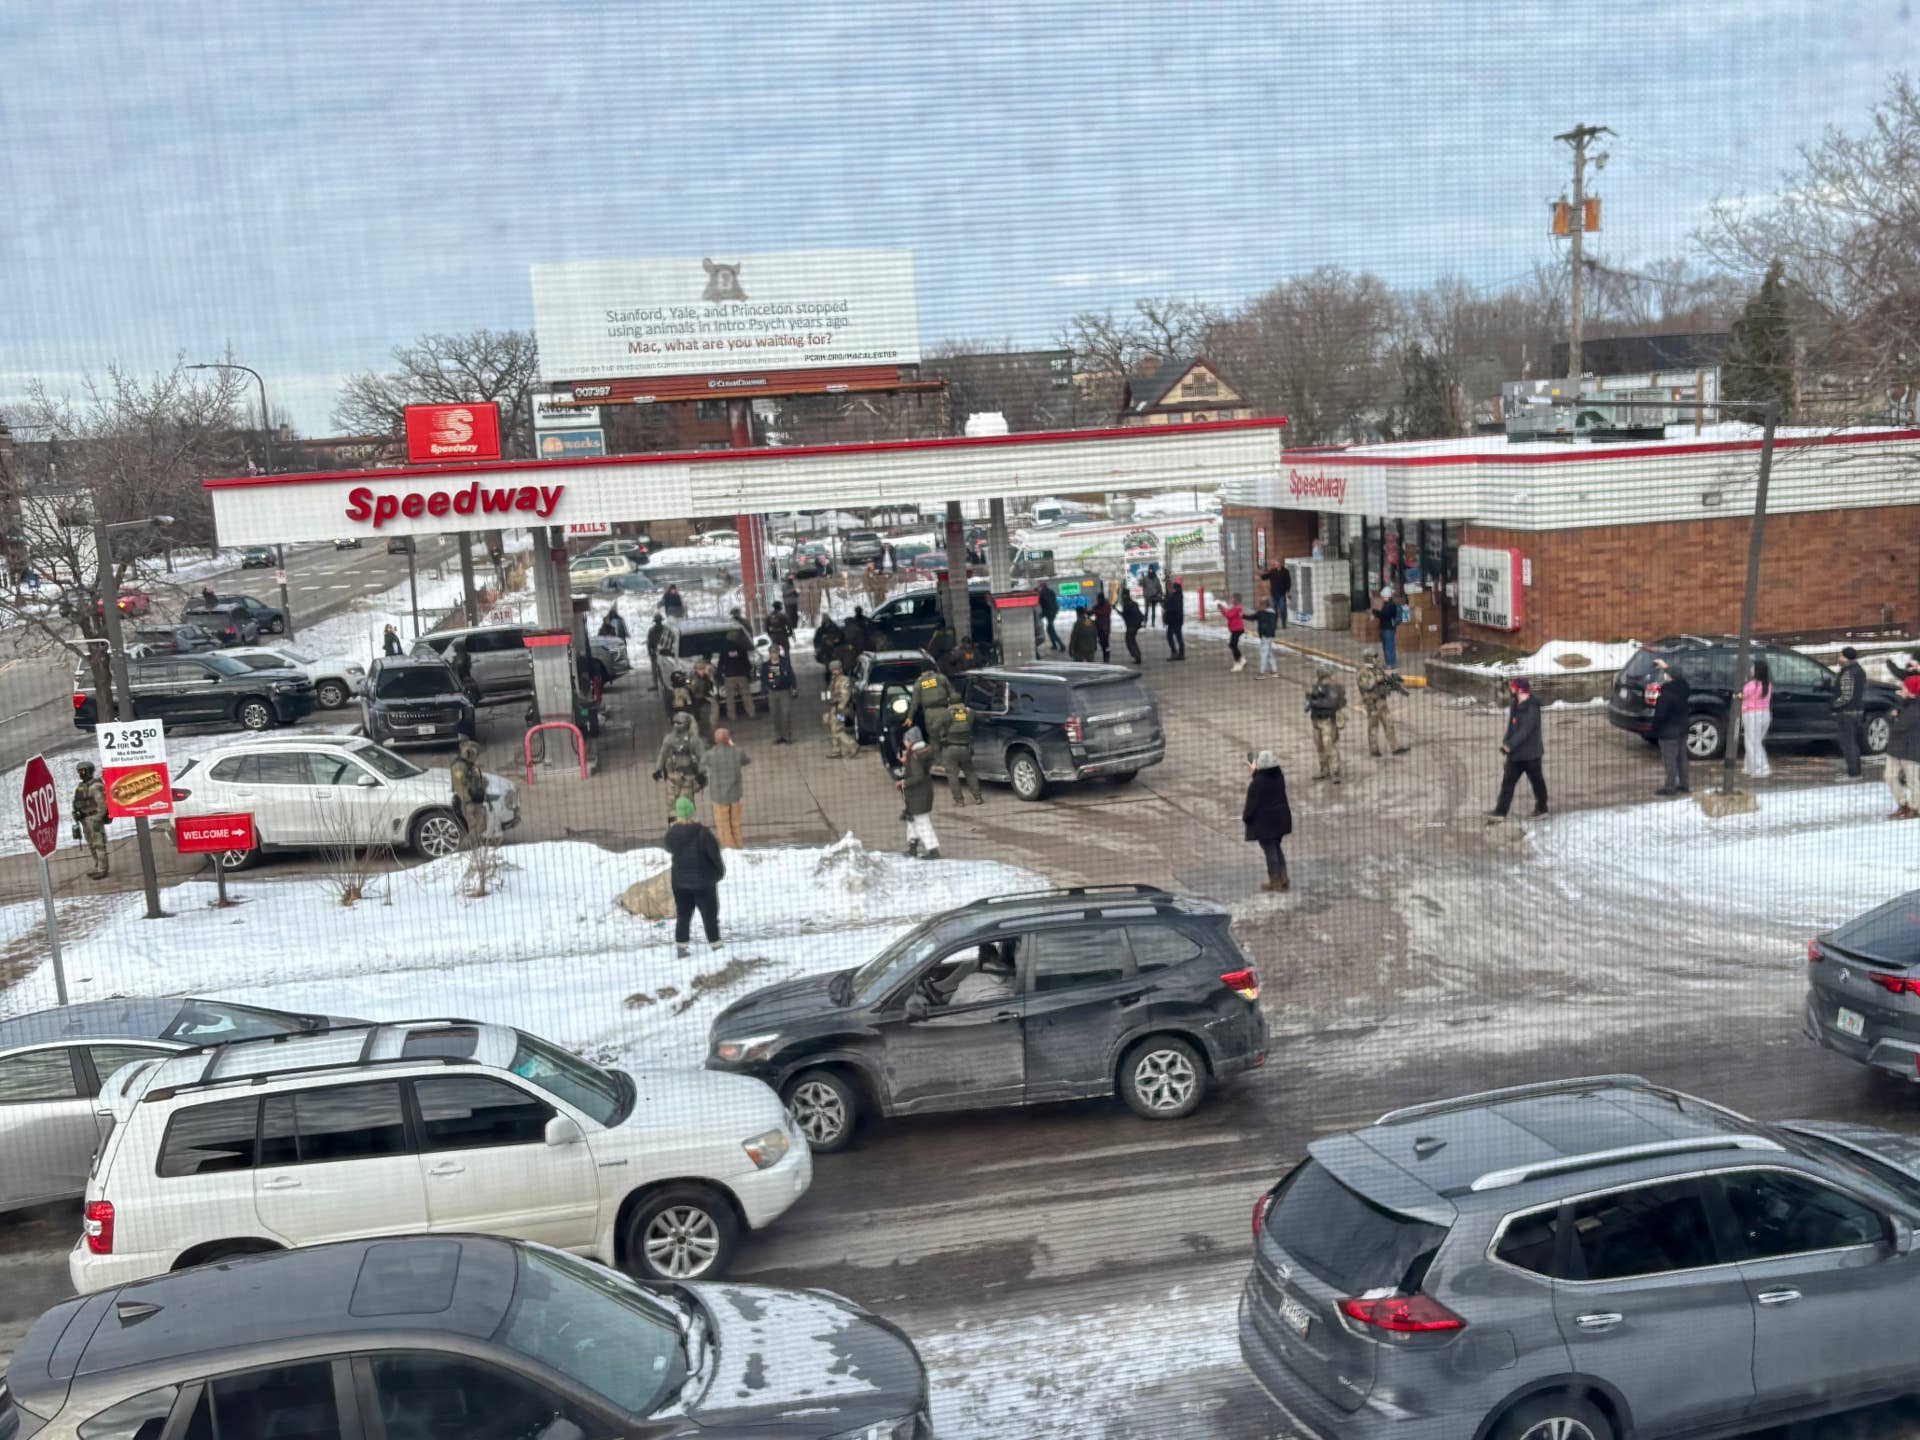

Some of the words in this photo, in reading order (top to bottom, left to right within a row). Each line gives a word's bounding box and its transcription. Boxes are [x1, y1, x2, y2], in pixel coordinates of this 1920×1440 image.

[606, 307, 666, 323] Stanford,
[669, 306, 700, 320] Yale,
[704, 304, 727, 318] and
[732, 302, 792, 317] Princeton
[796, 299, 848, 315] stopped
[607, 324, 642, 338] using
[645, 321, 695, 335] animals
[699, 319, 711, 333] in
[749, 317, 784, 332] Psych
[788, 317, 823, 331] years
[628, 340, 662, 354] Mac,
[664, 338, 699, 351] what
[702, 339, 723, 350] are
[727, 338, 752, 352] you
[755, 333, 803, 348] waiting
[807, 332, 832, 346] for?
[575, 386, 611, 397] 007397
[430, 443, 478, 455] Speedway
[1289, 468, 1347, 505] Speedway
[345, 481, 565, 529] Speedway
[570, 522, 606, 533] NAILS
[103, 731, 117, 750] 2
[26, 783, 54, 831] STOP
[183, 828, 230, 841] WELCOME
